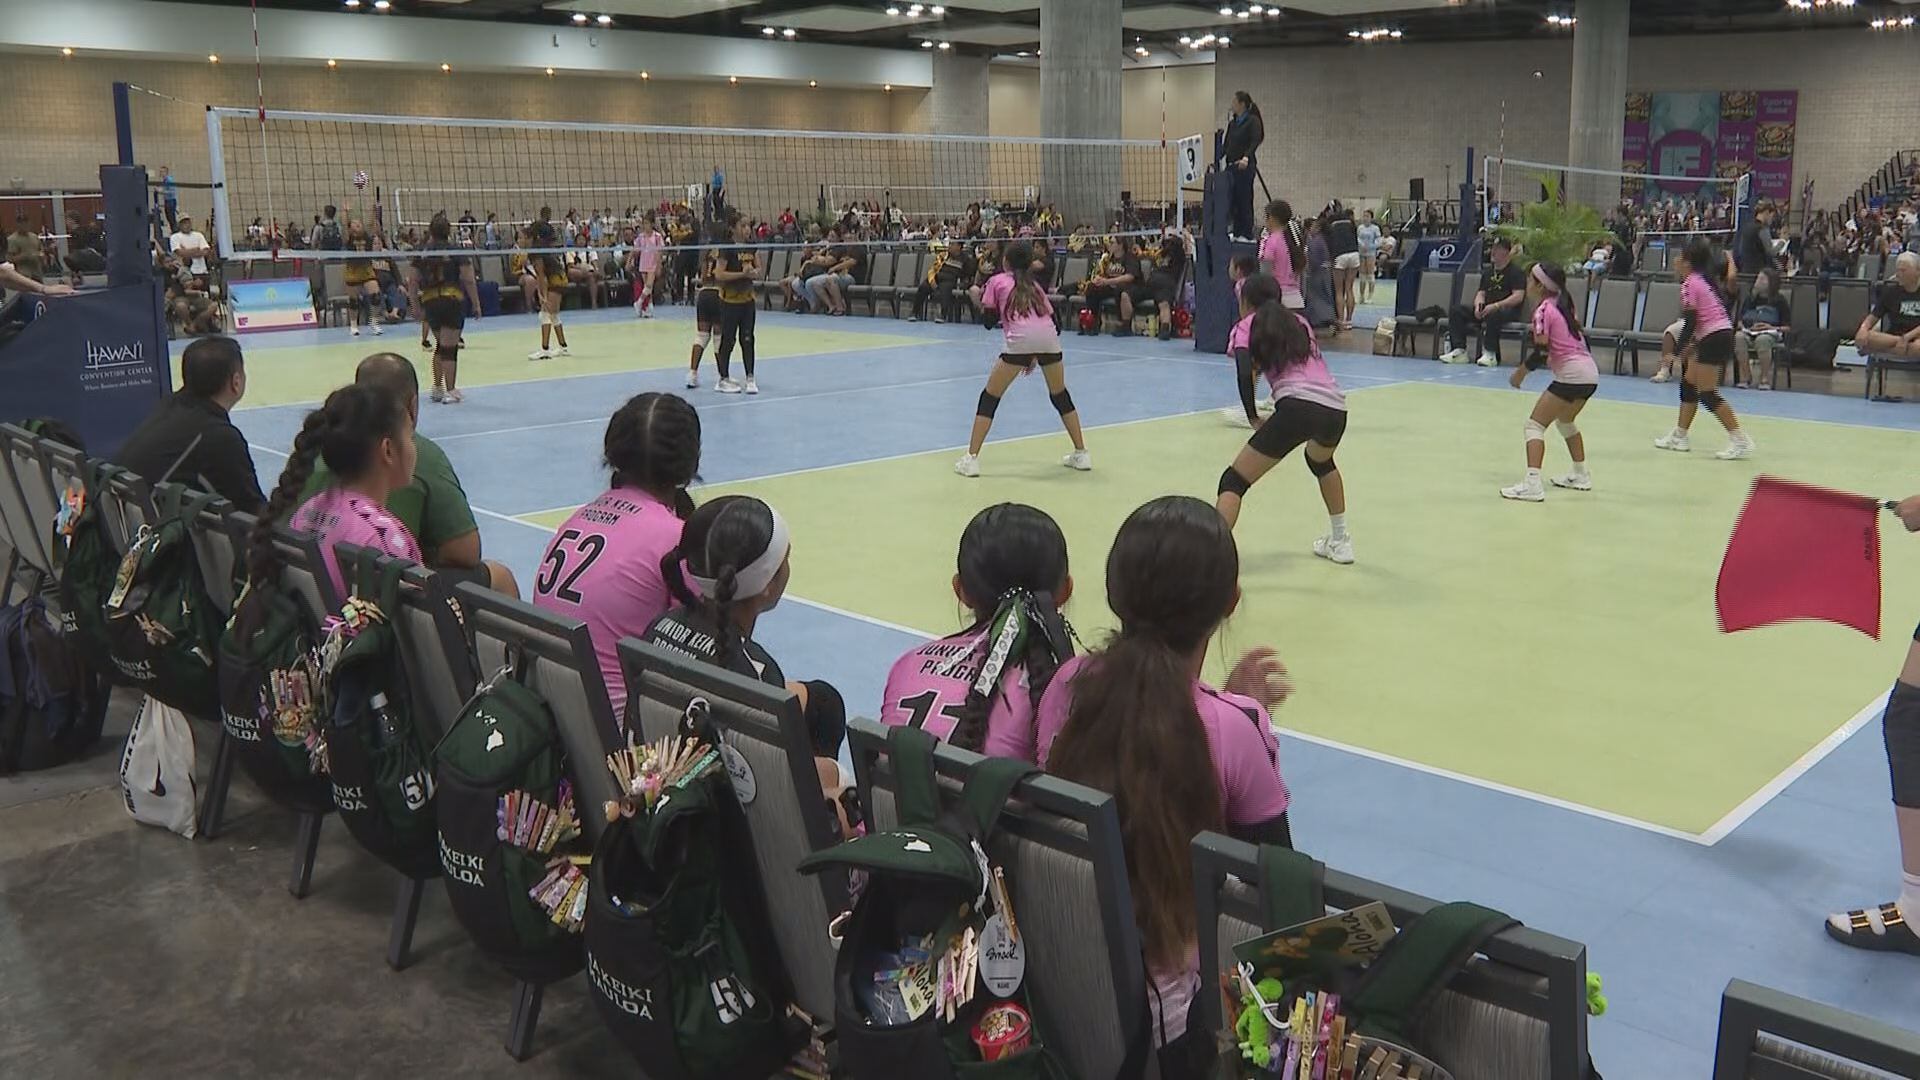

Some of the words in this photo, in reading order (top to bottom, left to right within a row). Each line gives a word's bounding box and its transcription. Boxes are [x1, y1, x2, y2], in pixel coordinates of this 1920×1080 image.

[1187, 147, 1195, 170] 9
[80, 370, 126, 380] CONVENTION
[127, 366, 153, 376] CENTER
[538, 530, 606, 605] 52
[446, 847, 485, 871] KEIKI
[600, 967, 653, 1004] KEIKI
